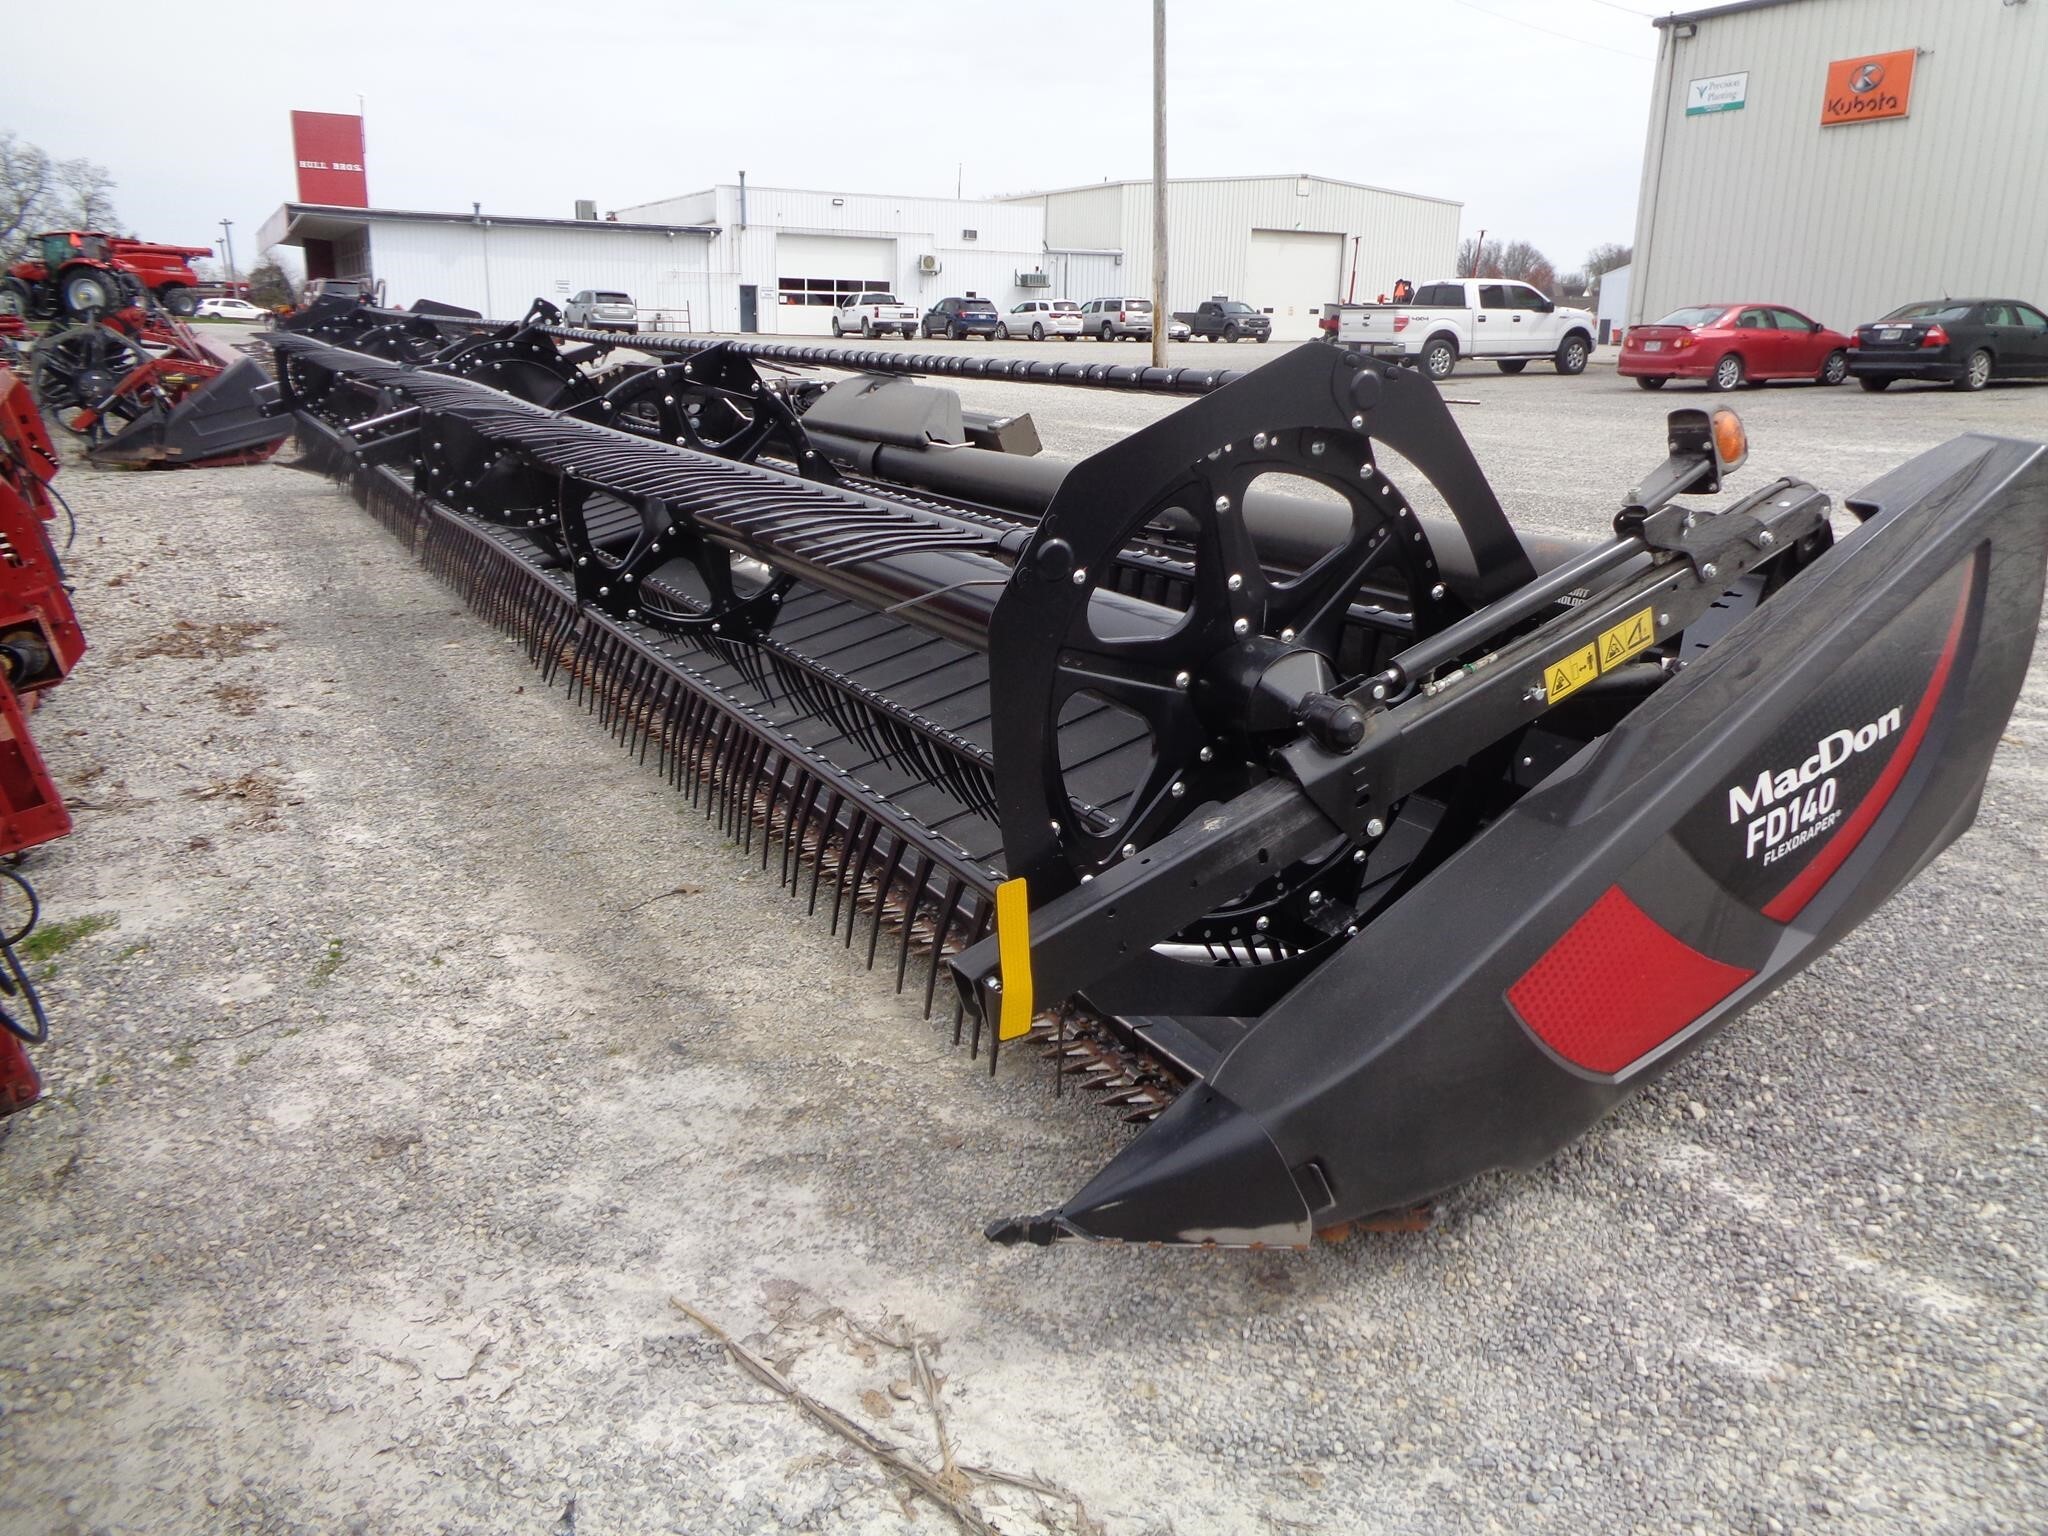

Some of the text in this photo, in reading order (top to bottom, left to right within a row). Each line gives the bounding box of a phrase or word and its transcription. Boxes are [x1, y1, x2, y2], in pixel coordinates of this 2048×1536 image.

[1827, 92, 1898, 116] Kubota
[1729, 706, 1901, 824] MacDon
[1746, 777, 1838, 859] FD140
